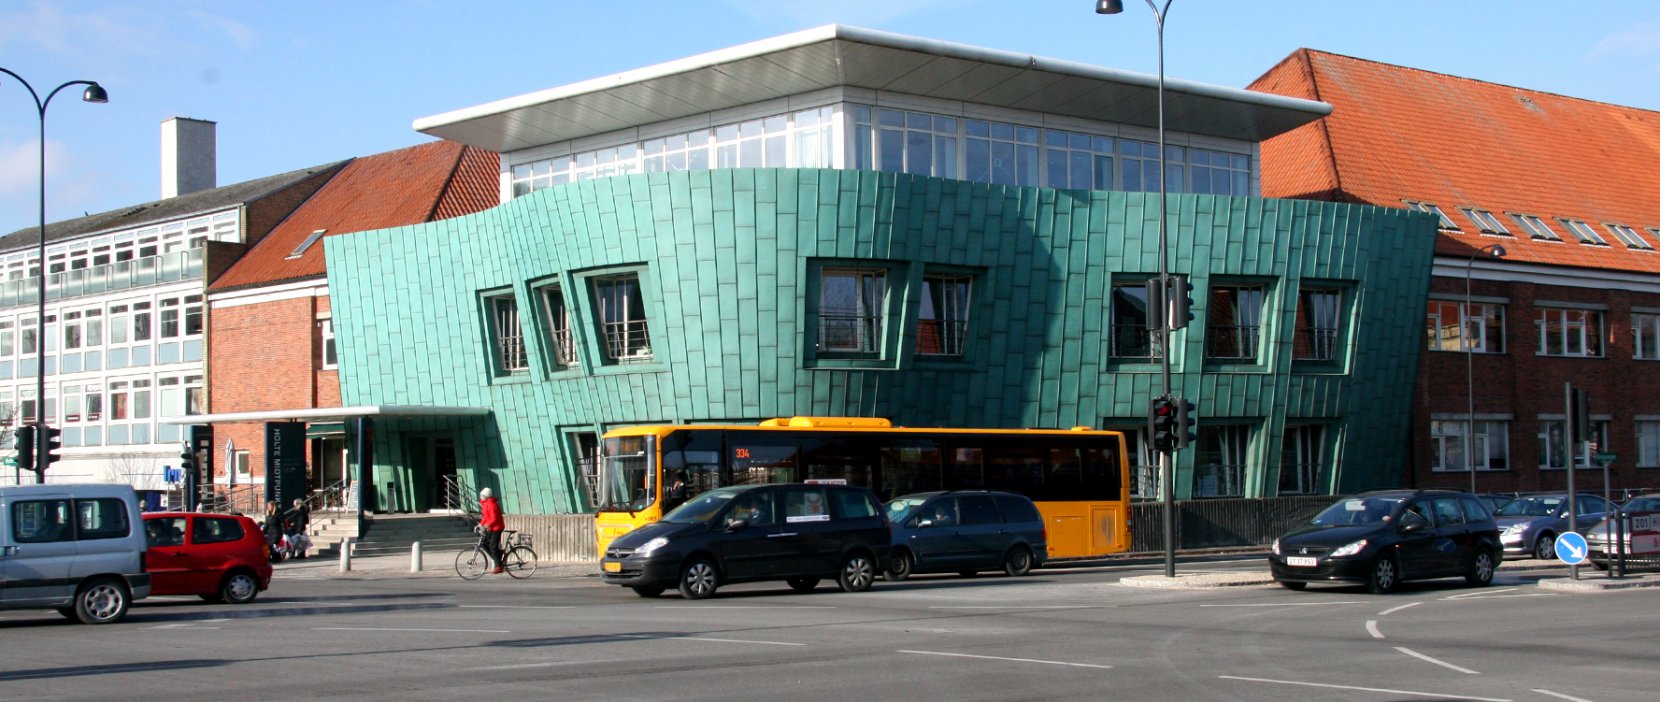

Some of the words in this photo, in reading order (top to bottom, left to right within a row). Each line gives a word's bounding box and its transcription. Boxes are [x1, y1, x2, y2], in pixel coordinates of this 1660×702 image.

[273, 428, 281, 456] HOLTE
[735, 448, 750, 458] 334
[1635, 518, 1648, 528] 201
